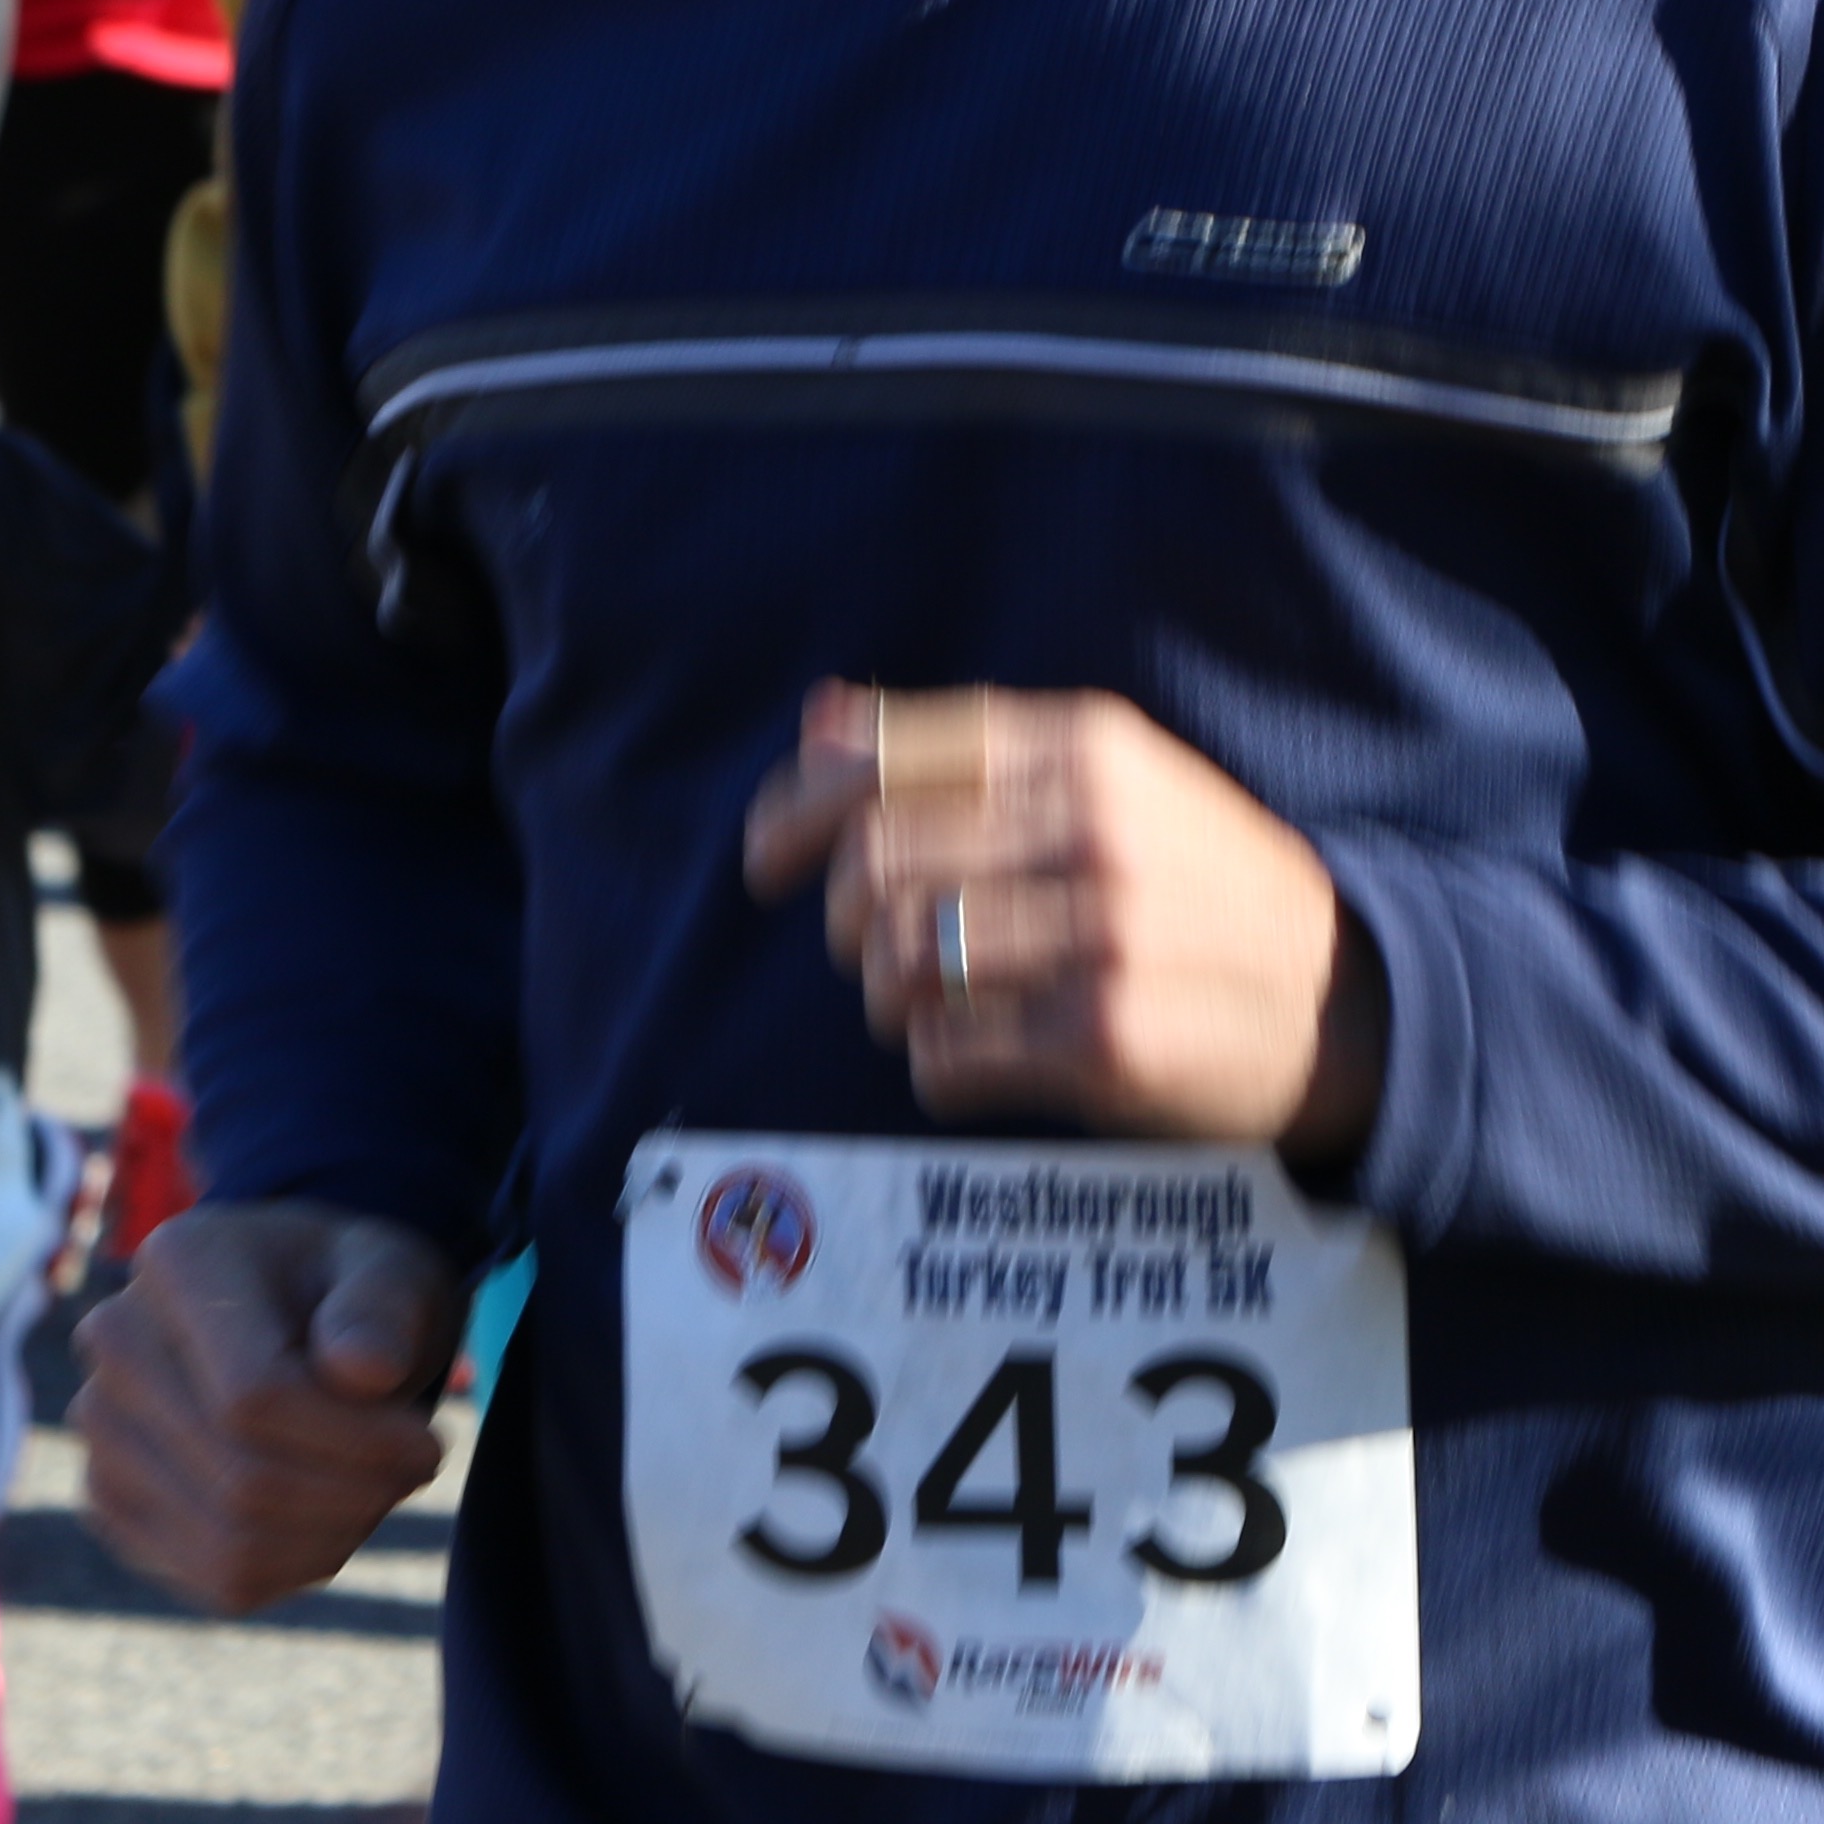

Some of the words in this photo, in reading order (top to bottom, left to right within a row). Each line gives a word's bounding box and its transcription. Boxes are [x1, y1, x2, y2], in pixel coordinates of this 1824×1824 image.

[919, 1164, 1254, 1248] Westborough
[900, 1240, 1070, 1329] Turkey
[1090, 1238, 1187, 1321] Trot
[733, 1340, 1287, 1592] 343
